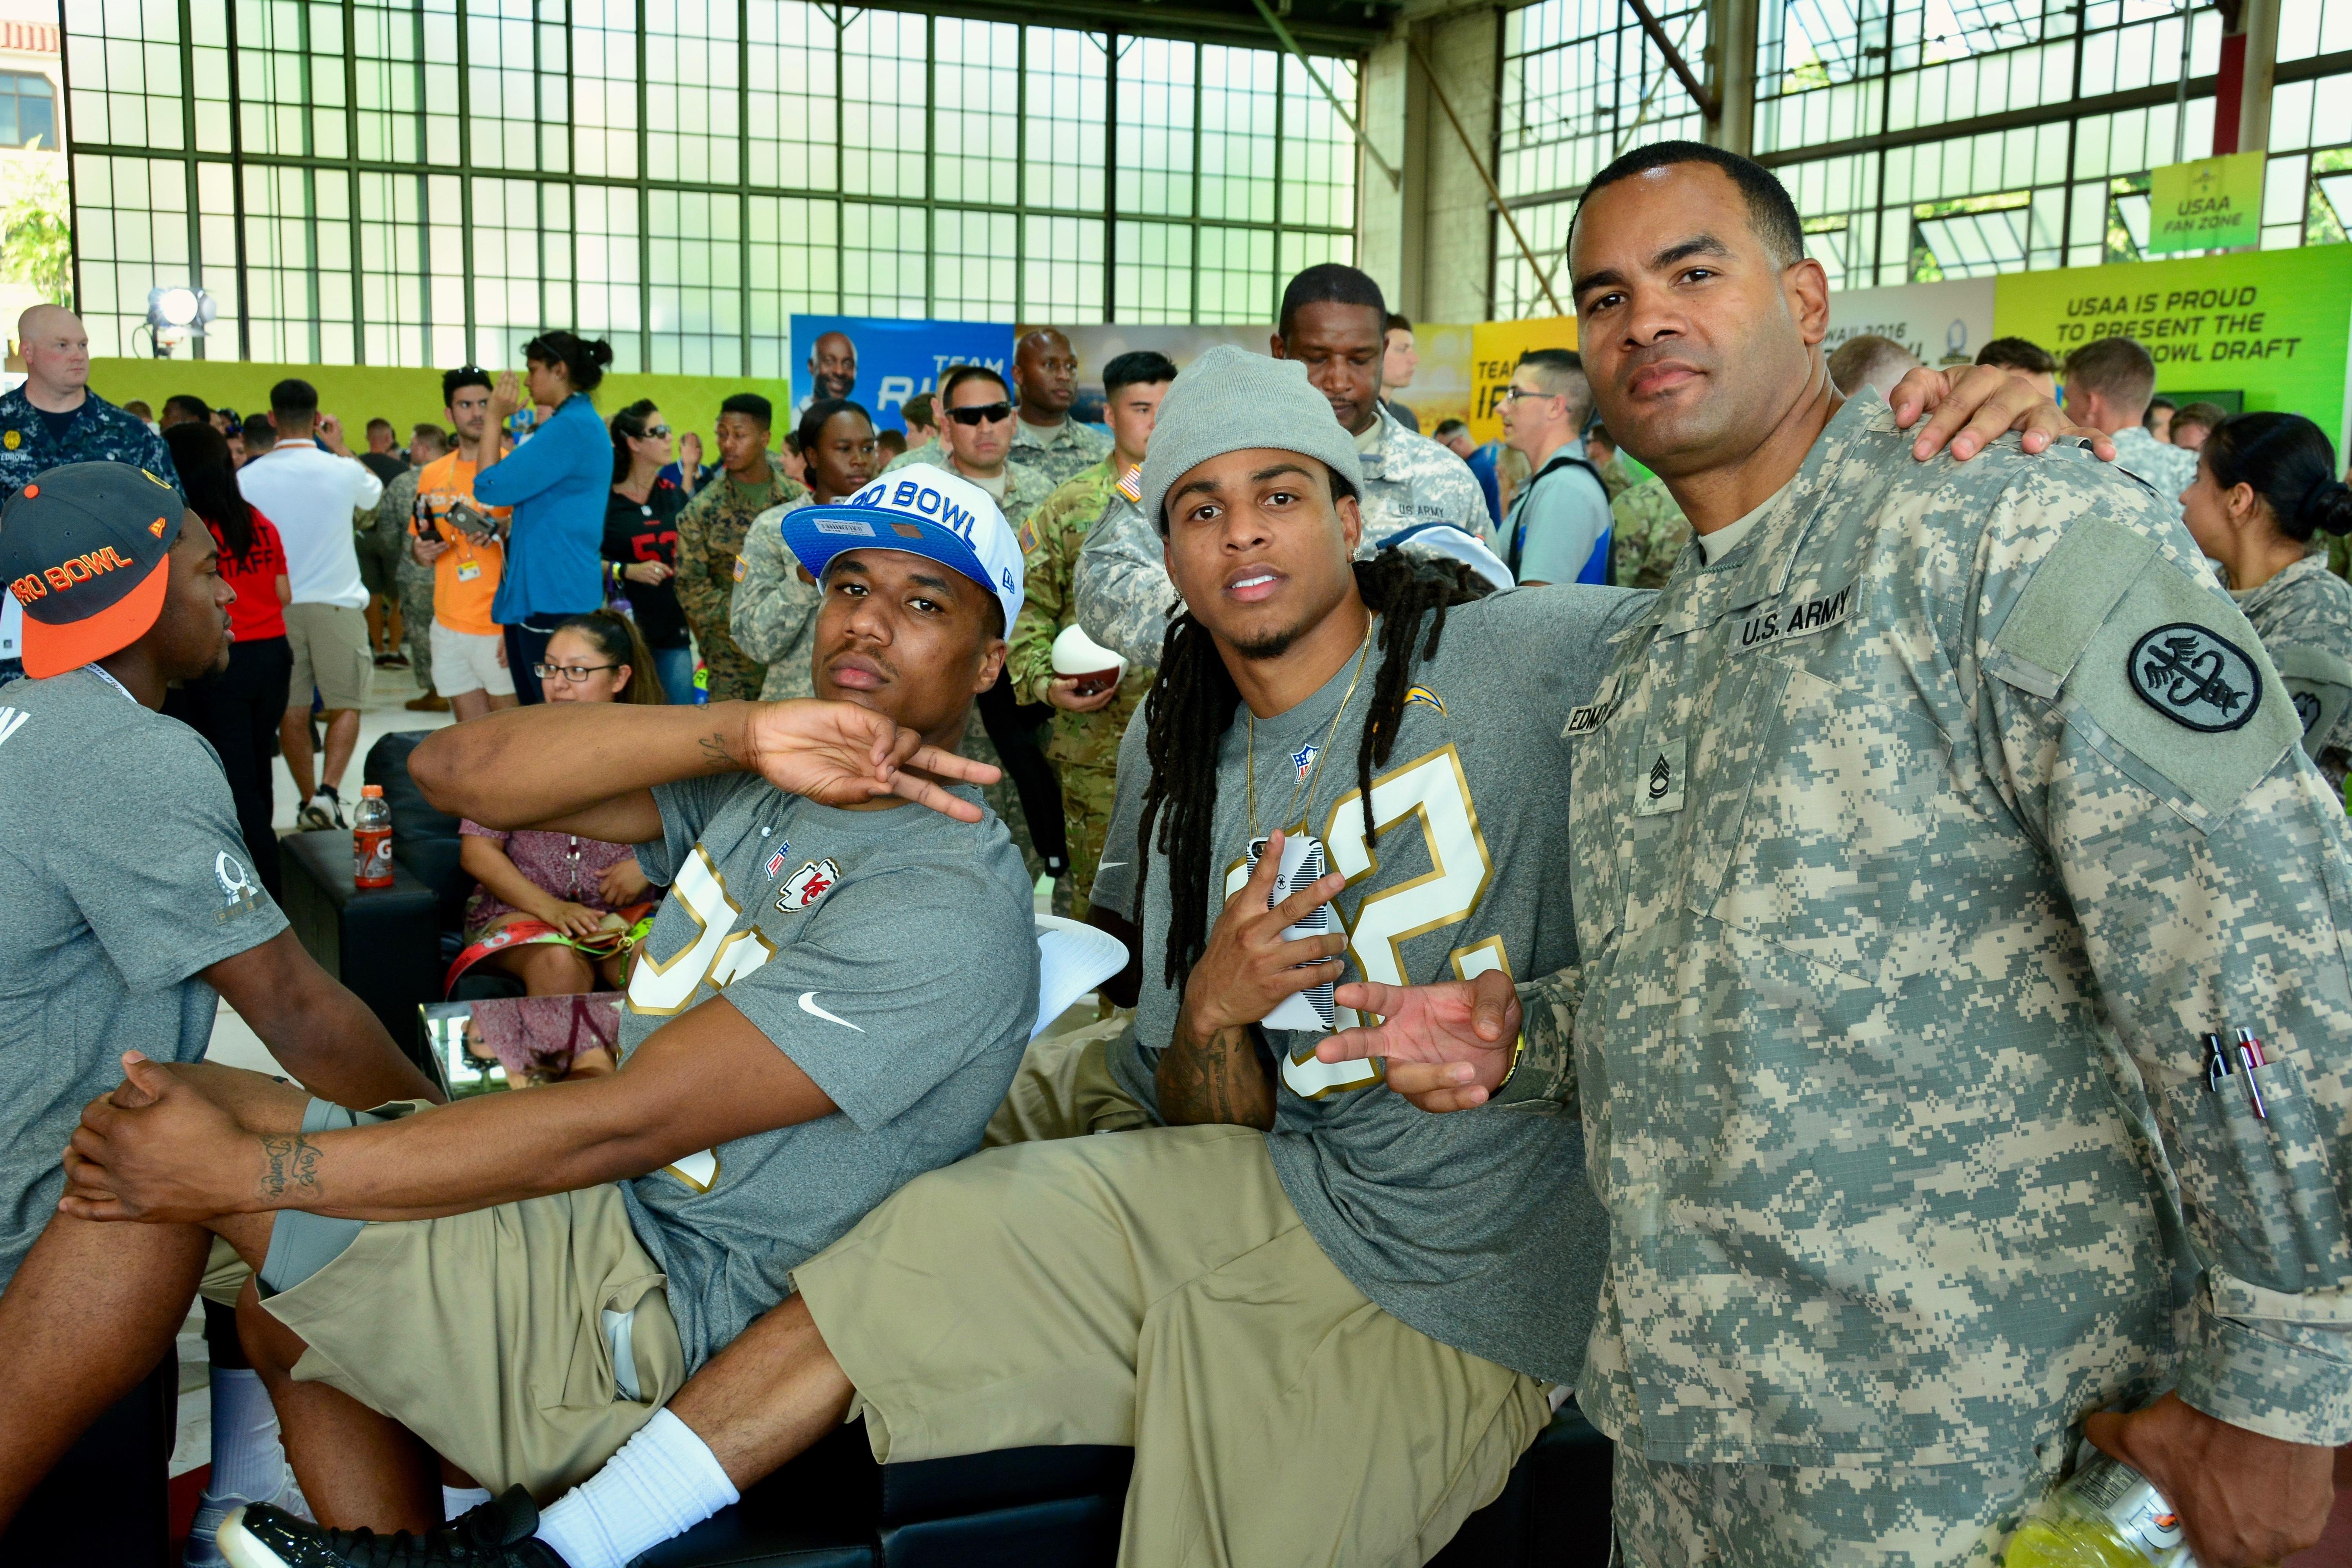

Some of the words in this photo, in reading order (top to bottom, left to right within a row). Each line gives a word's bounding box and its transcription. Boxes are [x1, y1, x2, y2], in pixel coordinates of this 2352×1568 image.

[2178, 195, 2230, 217] USAA
[2067, 296, 2128, 318] USAA
[2134, 293, 2158, 313] IS
[2165, 285, 2257, 311] PROUD
[2056, 322, 2085, 343] TO
[2092, 316, 2205, 340] PRESENT
[2214, 312, 2265, 335] THE
[2153, 343, 2203, 364] OWL
[2210, 337, 2302, 361] DRAFT
[891, 481, 976, 551] BOWL
[1418, 505, 1444, 518] ARMY
[44, 546, 134, 593] BOWL
[216, 548, 274, 579] TAFF
[1742, 613, 1779, 646] U.S.
[1786, 585, 1851, 633] ARMY
